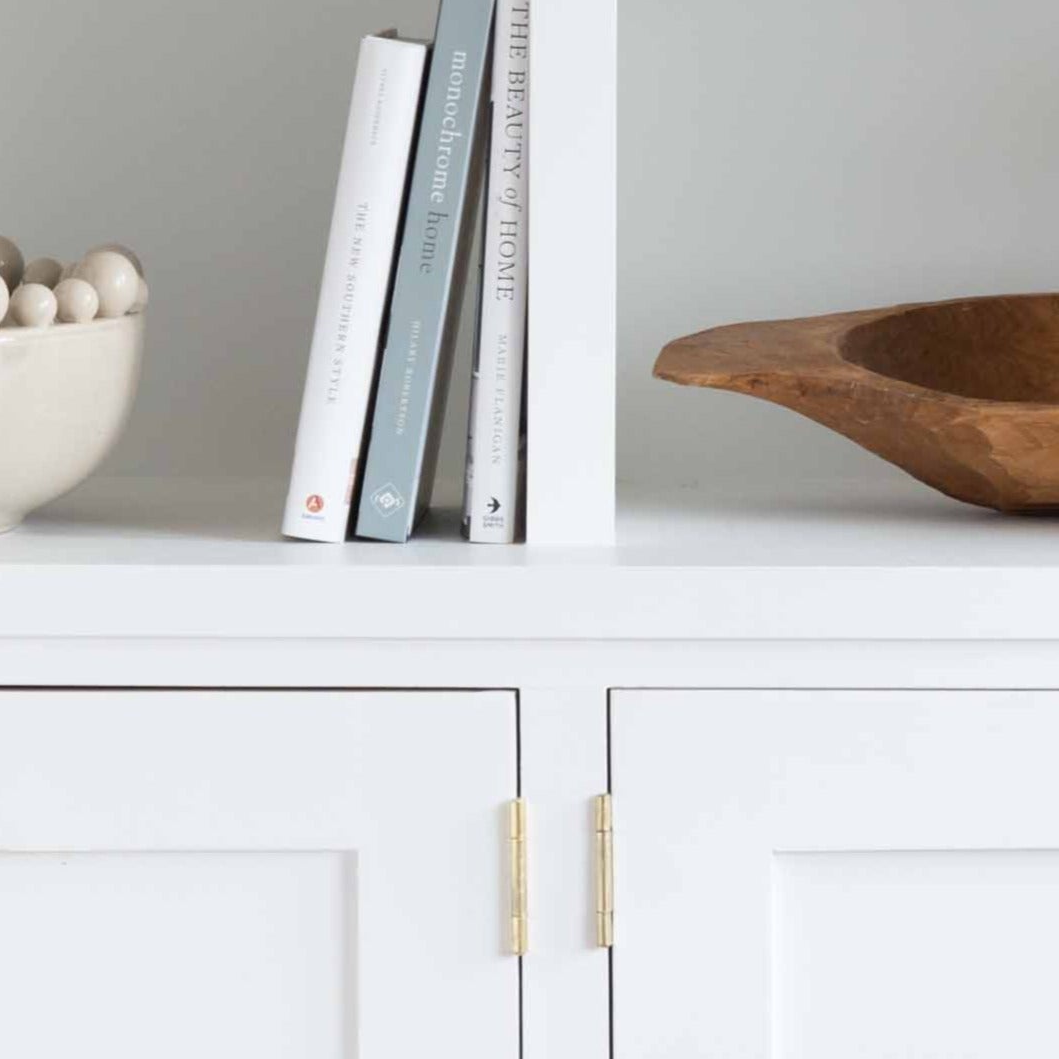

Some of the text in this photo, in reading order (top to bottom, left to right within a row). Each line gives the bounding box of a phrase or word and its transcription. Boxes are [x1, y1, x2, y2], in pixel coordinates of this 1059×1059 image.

[420, 50, 467, 274] monochrome home
[496, 2, 529, 301] THE BEAUTY of HOME
